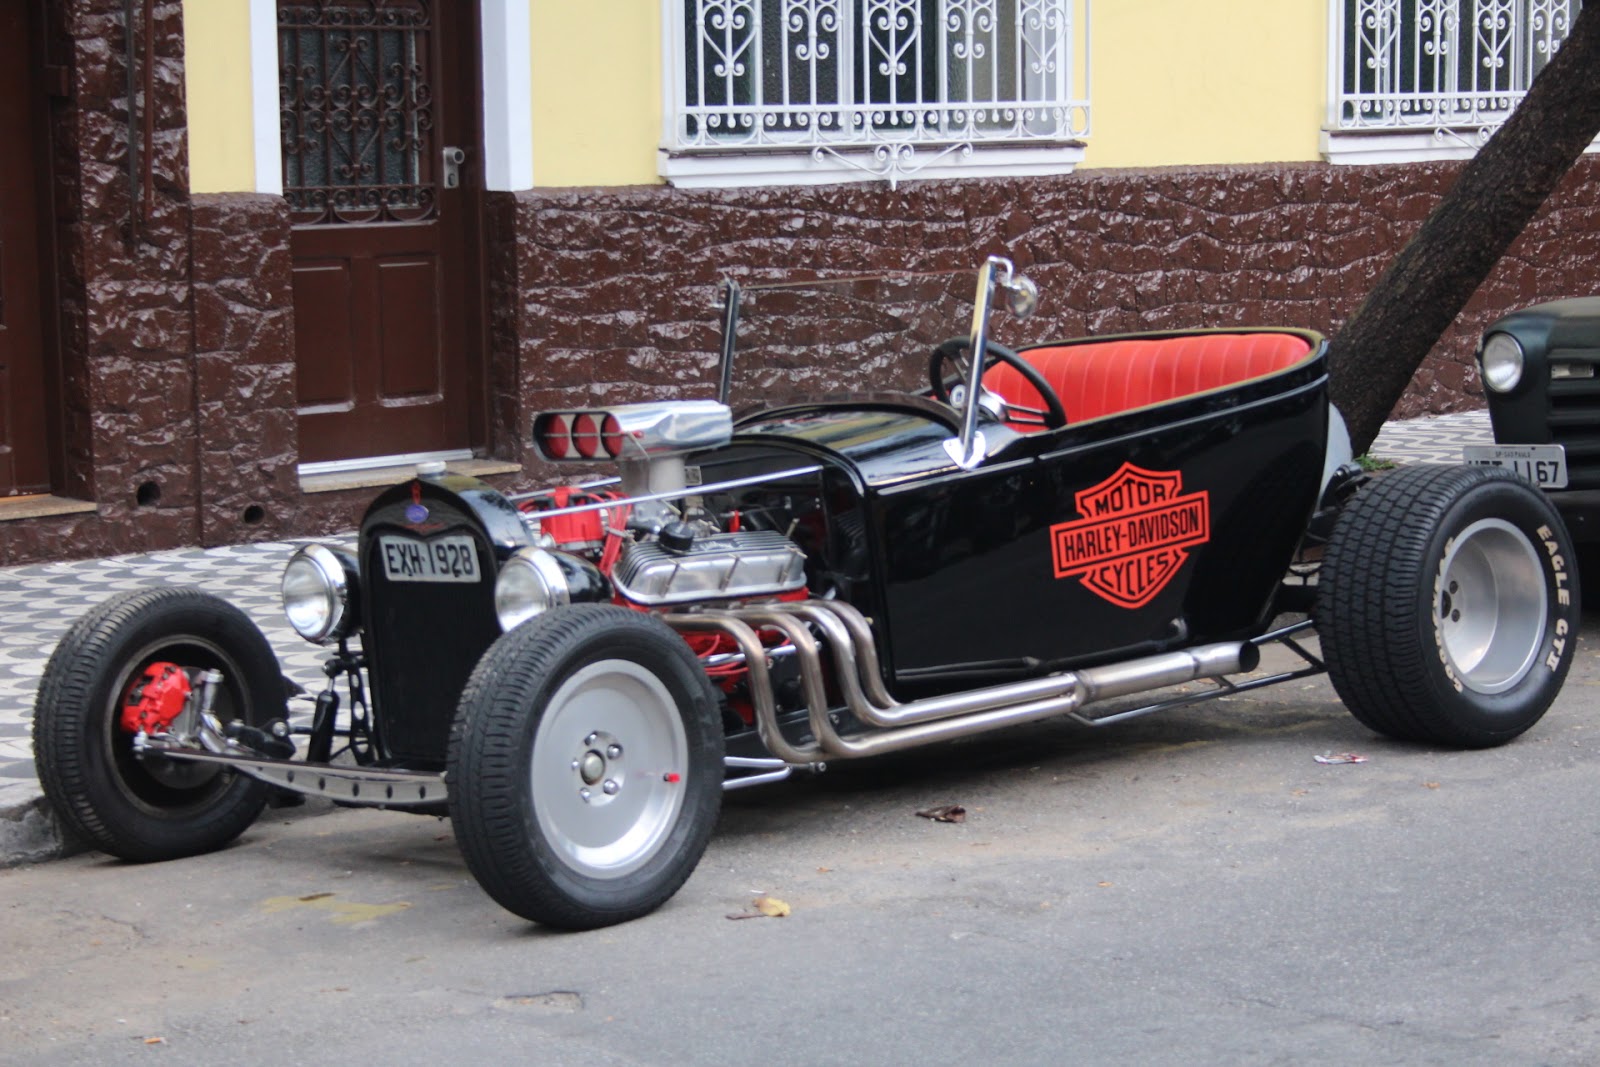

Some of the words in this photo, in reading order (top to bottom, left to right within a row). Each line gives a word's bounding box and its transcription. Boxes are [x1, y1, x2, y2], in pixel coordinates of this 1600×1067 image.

[1095, 478, 1166, 515] MOTOR
[1064, 505, 1199, 562] HARLEY-DAVIDSON
[1100, 552, 1169, 596] CYCLES
[1536, 524, 1570, 606] EAGLE
